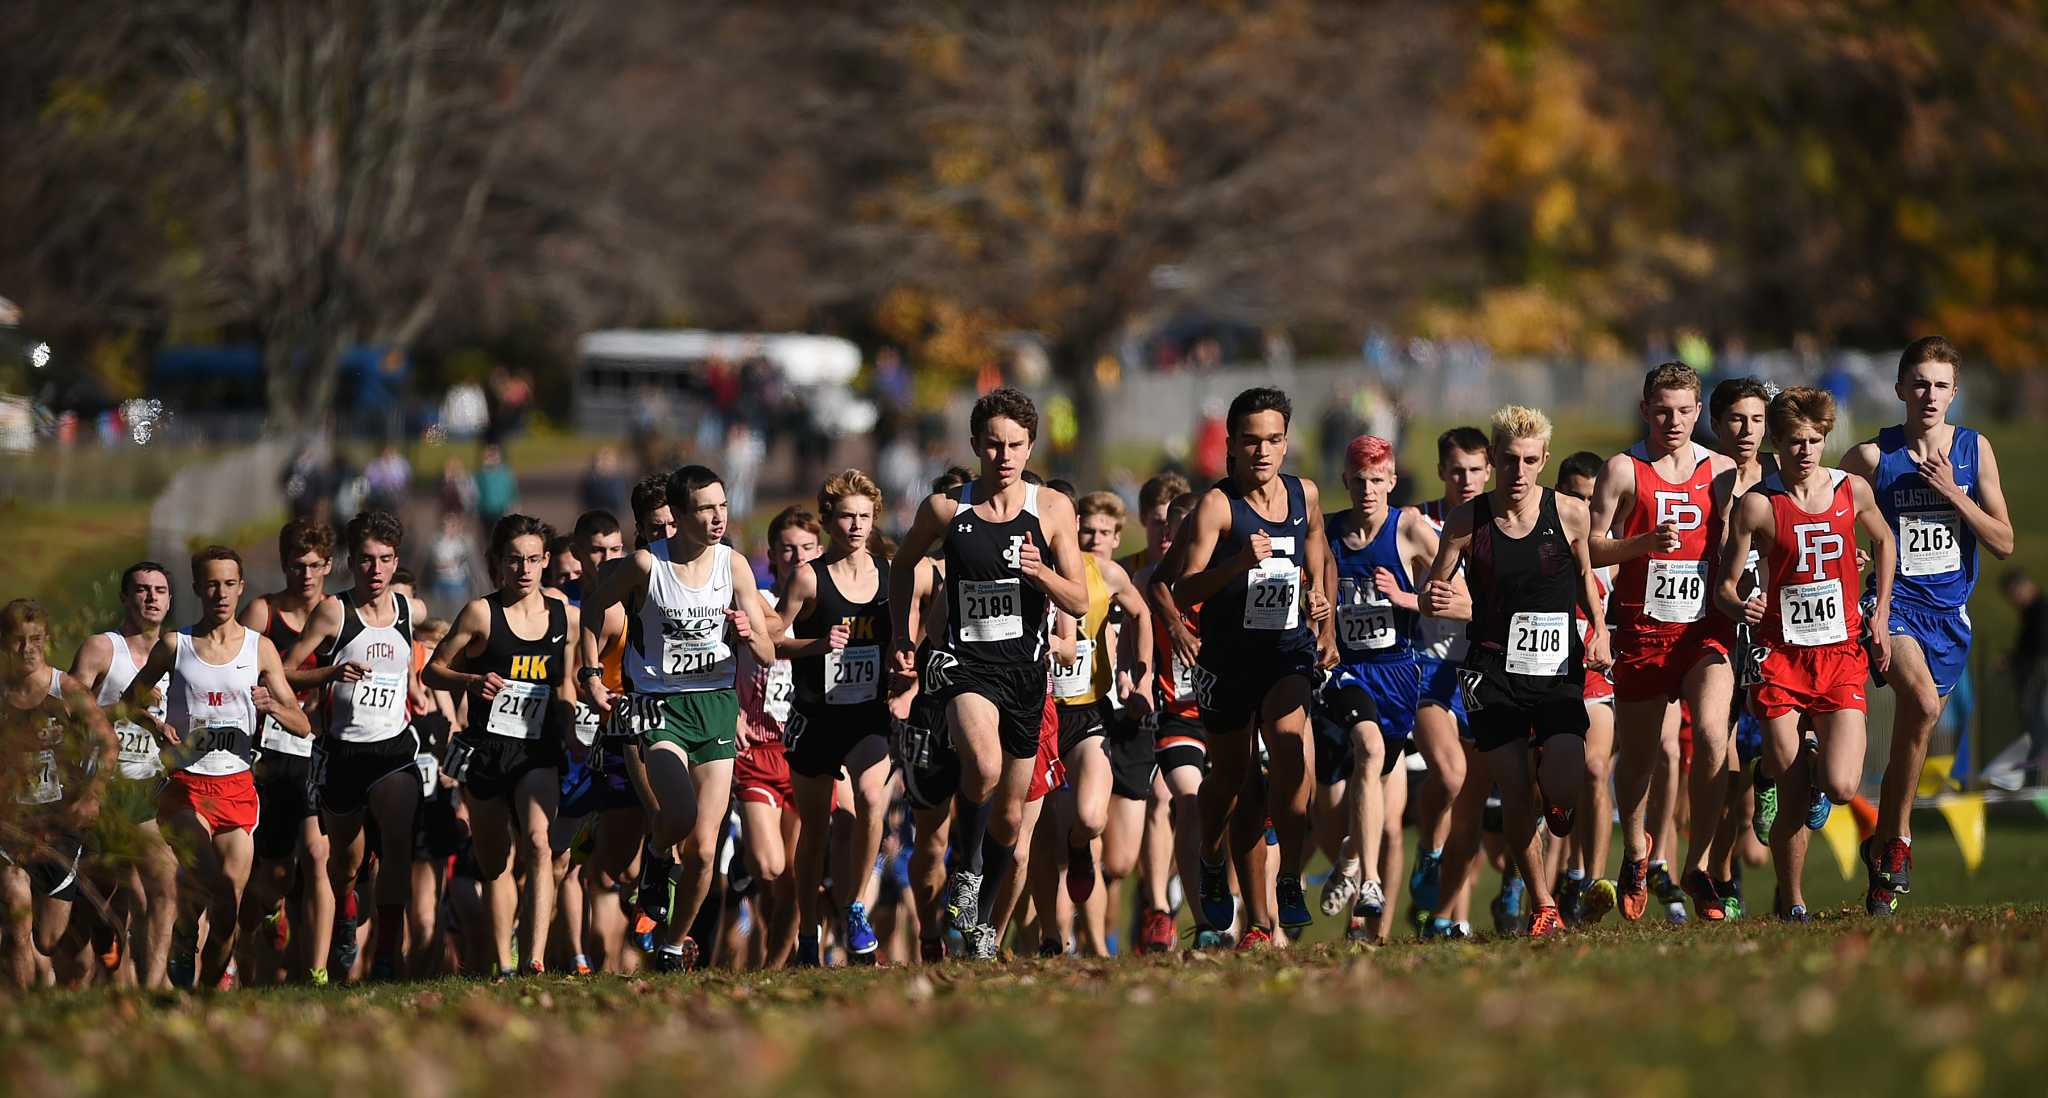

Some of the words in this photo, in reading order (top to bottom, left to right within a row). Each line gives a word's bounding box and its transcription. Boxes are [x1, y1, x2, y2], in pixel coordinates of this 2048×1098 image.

[1793, 522, 1844, 580] FP
[1909, 526, 1954, 552] 2163
[1654, 575, 1700, 600] 2148
[658, 606, 683, 618] New
[687, 604, 725, 617] Milford
[967, 595, 1013, 619] 2189
[1790, 596, 1836, 624] 2146
[1345, 616, 1388, 642] 2213
[1517, 627, 1560, 652] 2108
[366, 642, 394, 661] FITCH
[510, 655, 551, 679] HK
[672, 652, 715, 676] 2210
[834, 661, 874, 684] 2179
[207, 691, 222, 706] M
[359, 685, 396, 710] 2157
[499, 694, 544, 719] 2177
[117, 731, 150, 754] 2211
[195, 730, 235, 752] 2200
